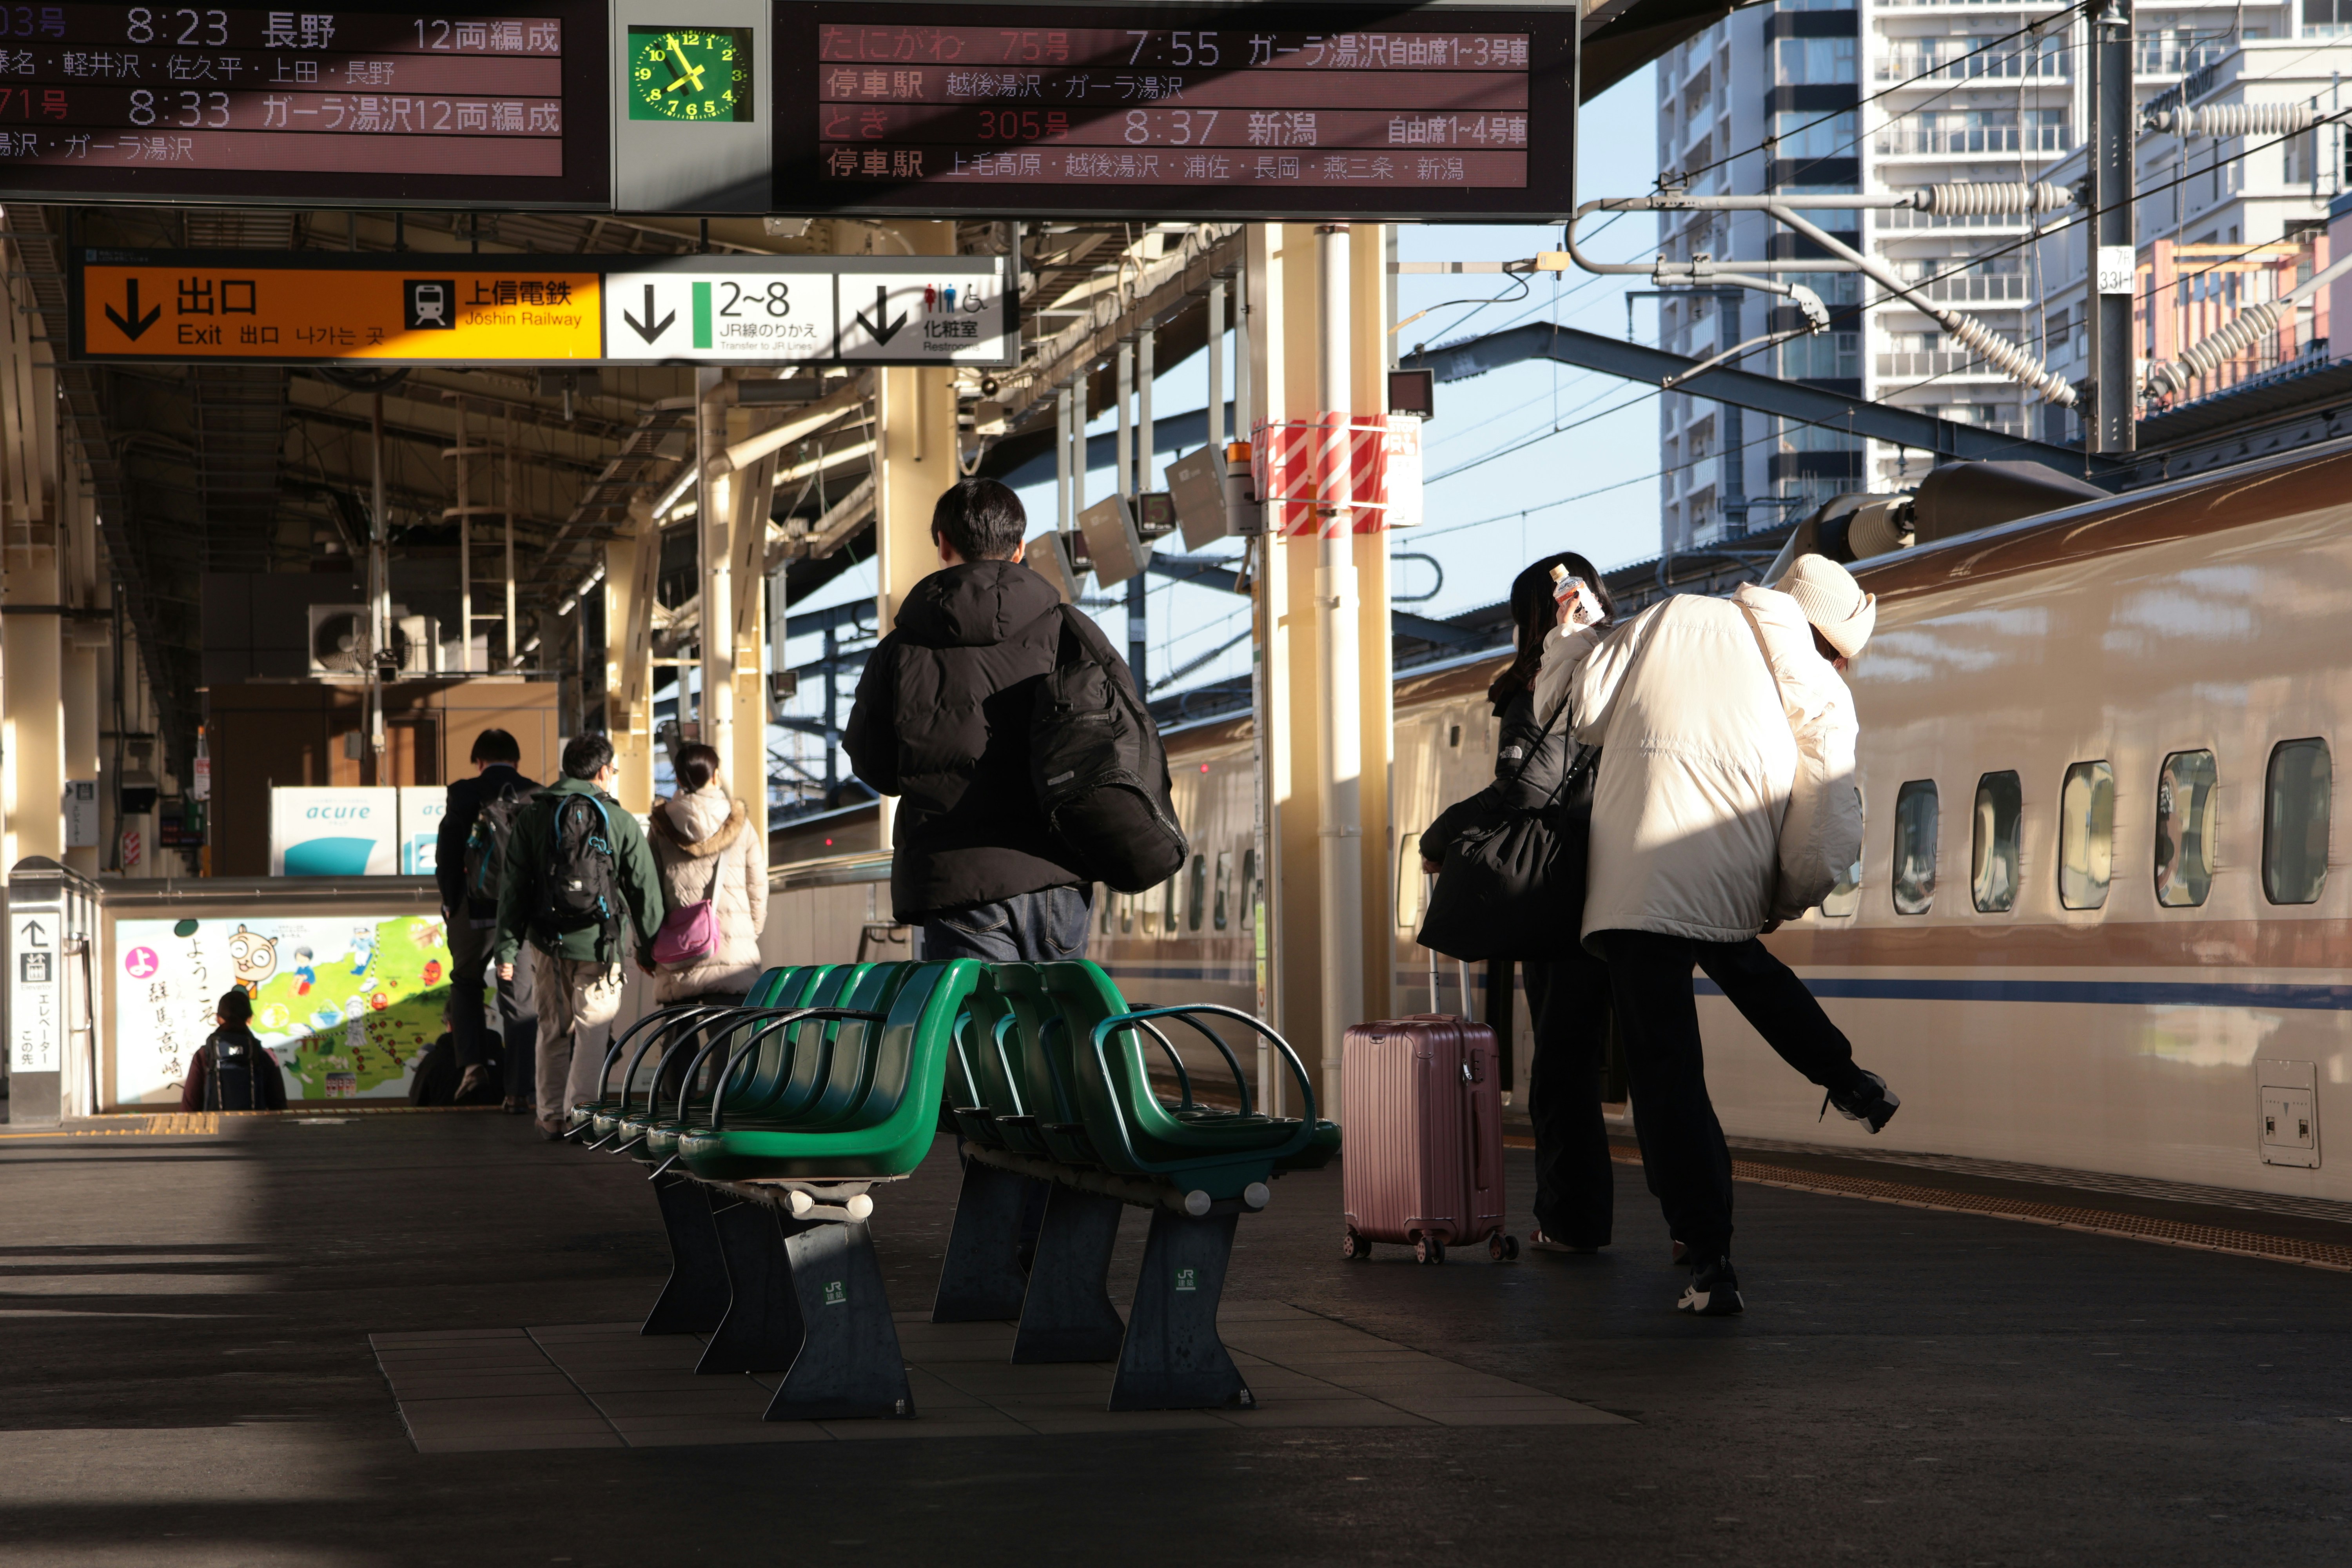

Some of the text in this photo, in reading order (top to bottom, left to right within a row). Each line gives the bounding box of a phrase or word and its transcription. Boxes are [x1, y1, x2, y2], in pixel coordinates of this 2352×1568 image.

[127, 7, 228, 46] 8:23
[261, 11, 336, 49] 長野
[413, 19, 558, 52] 12両編成
[682, 34, 699, 45] 12
[706, 38, 713, 49] 1
[822, 27, 964, 59] たにがわ
[999, 31, 1070, 62] 75号
[1126, 31, 1219, 66] 7:55
[649, 50, 666, 61] 10
[722, 49, 733, 61] 2
[639, 68, 652, 80] 9
[731, 70, 742, 81] 3
[826, 69, 923, 99] 停車駅
[650, 88, 662, 100] 8
[722, 89, 733, 101] 4
[129, 90, 230, 128] 8:33
[668, 100, 679, 112] 7
[686, 103, 697, 115] 6
[704, 100, 715, 113] 5
[824, 107, 887, 139] とき
[978, 111, 1070, 140] 305号
[1124, 110, 1219, 145] 8:37
[1248, 112, 1317, 146] 新潟
[827, 149, 923, 178] 停車駅
[2100, 271, 2133, 289] 331-1
[176, 277, 257, 316] 出口
[465, 281, 572, 307] 上信電鉄
[720, 281, 791, 317] 2~8
[520, 311, 582, 329] Railway
[176, 324, 385, 346] Exit 出口 나가는 곳
[719, 323, 817, 339] JR線のりかえ
[923, 320, 979, 338] 化粧室
[720, 341, 813, 351] Transfer to JR Lines
[923, 341, 980, 352] Restrooms
[1388, 422, 1416, 433] STOP
[1147, 497, 1168, 522] 5
[306, 807, 370, 819] acure
[187, 938, 218, 1027] ようこそ
[39, 995, 51, 1063] エレベーター
[22, 1031, 33, 1065] この先
[1177, 1269, 1194, 1279] JR
[825, 1281, 842, 1293] JR
[1178, 1279, 1194, 1287] 建築
[826, 1291, 844, 1301] 建築
